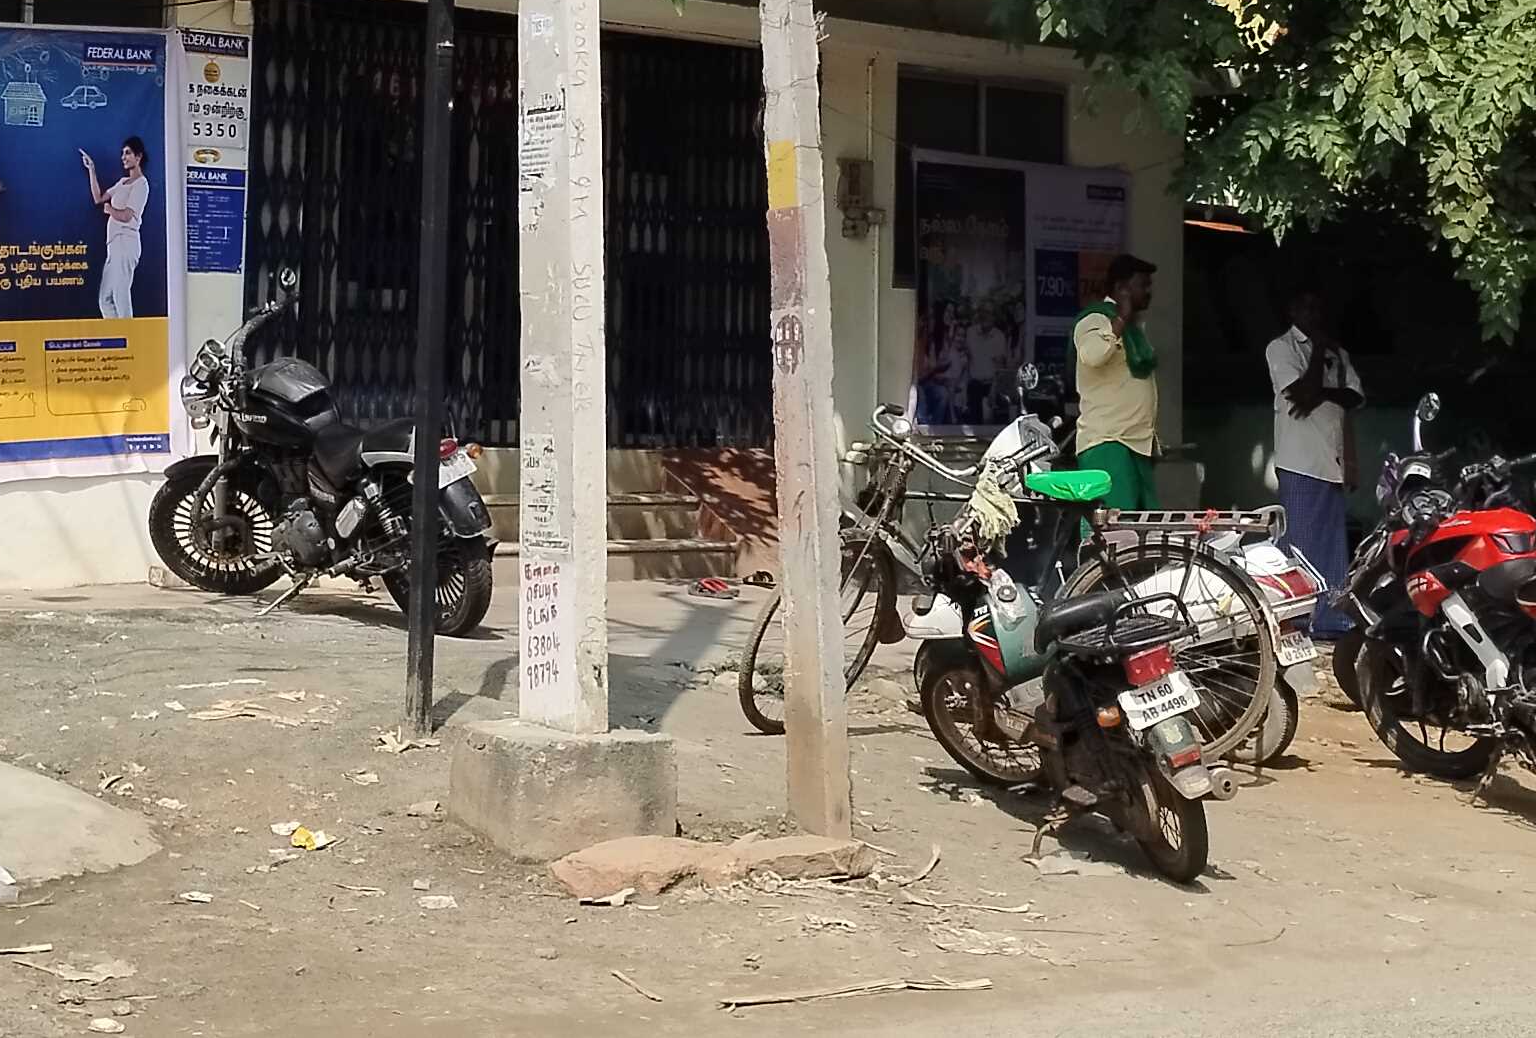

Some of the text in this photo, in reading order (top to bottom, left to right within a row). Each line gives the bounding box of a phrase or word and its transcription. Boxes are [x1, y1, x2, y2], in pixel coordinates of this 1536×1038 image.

[183, 34, 245, 50] EDERAL BANK
[87, 47, 153, 61] FEDERAL BANK
[192, 122, 237, 138] 5350
[186, 170, 206, 180] DERAL
[208, 171, 228, 181] BANK
[11, 259, 36, 274] புதிய
[16, 274, 41, 290] புதிய
[527, 631, 561, 659] 63804
[526, 659, 560, 691] 98794
[1137, 683, 1173, 705] TN 60
[1142, 695, 1188, 723] AB 4498
